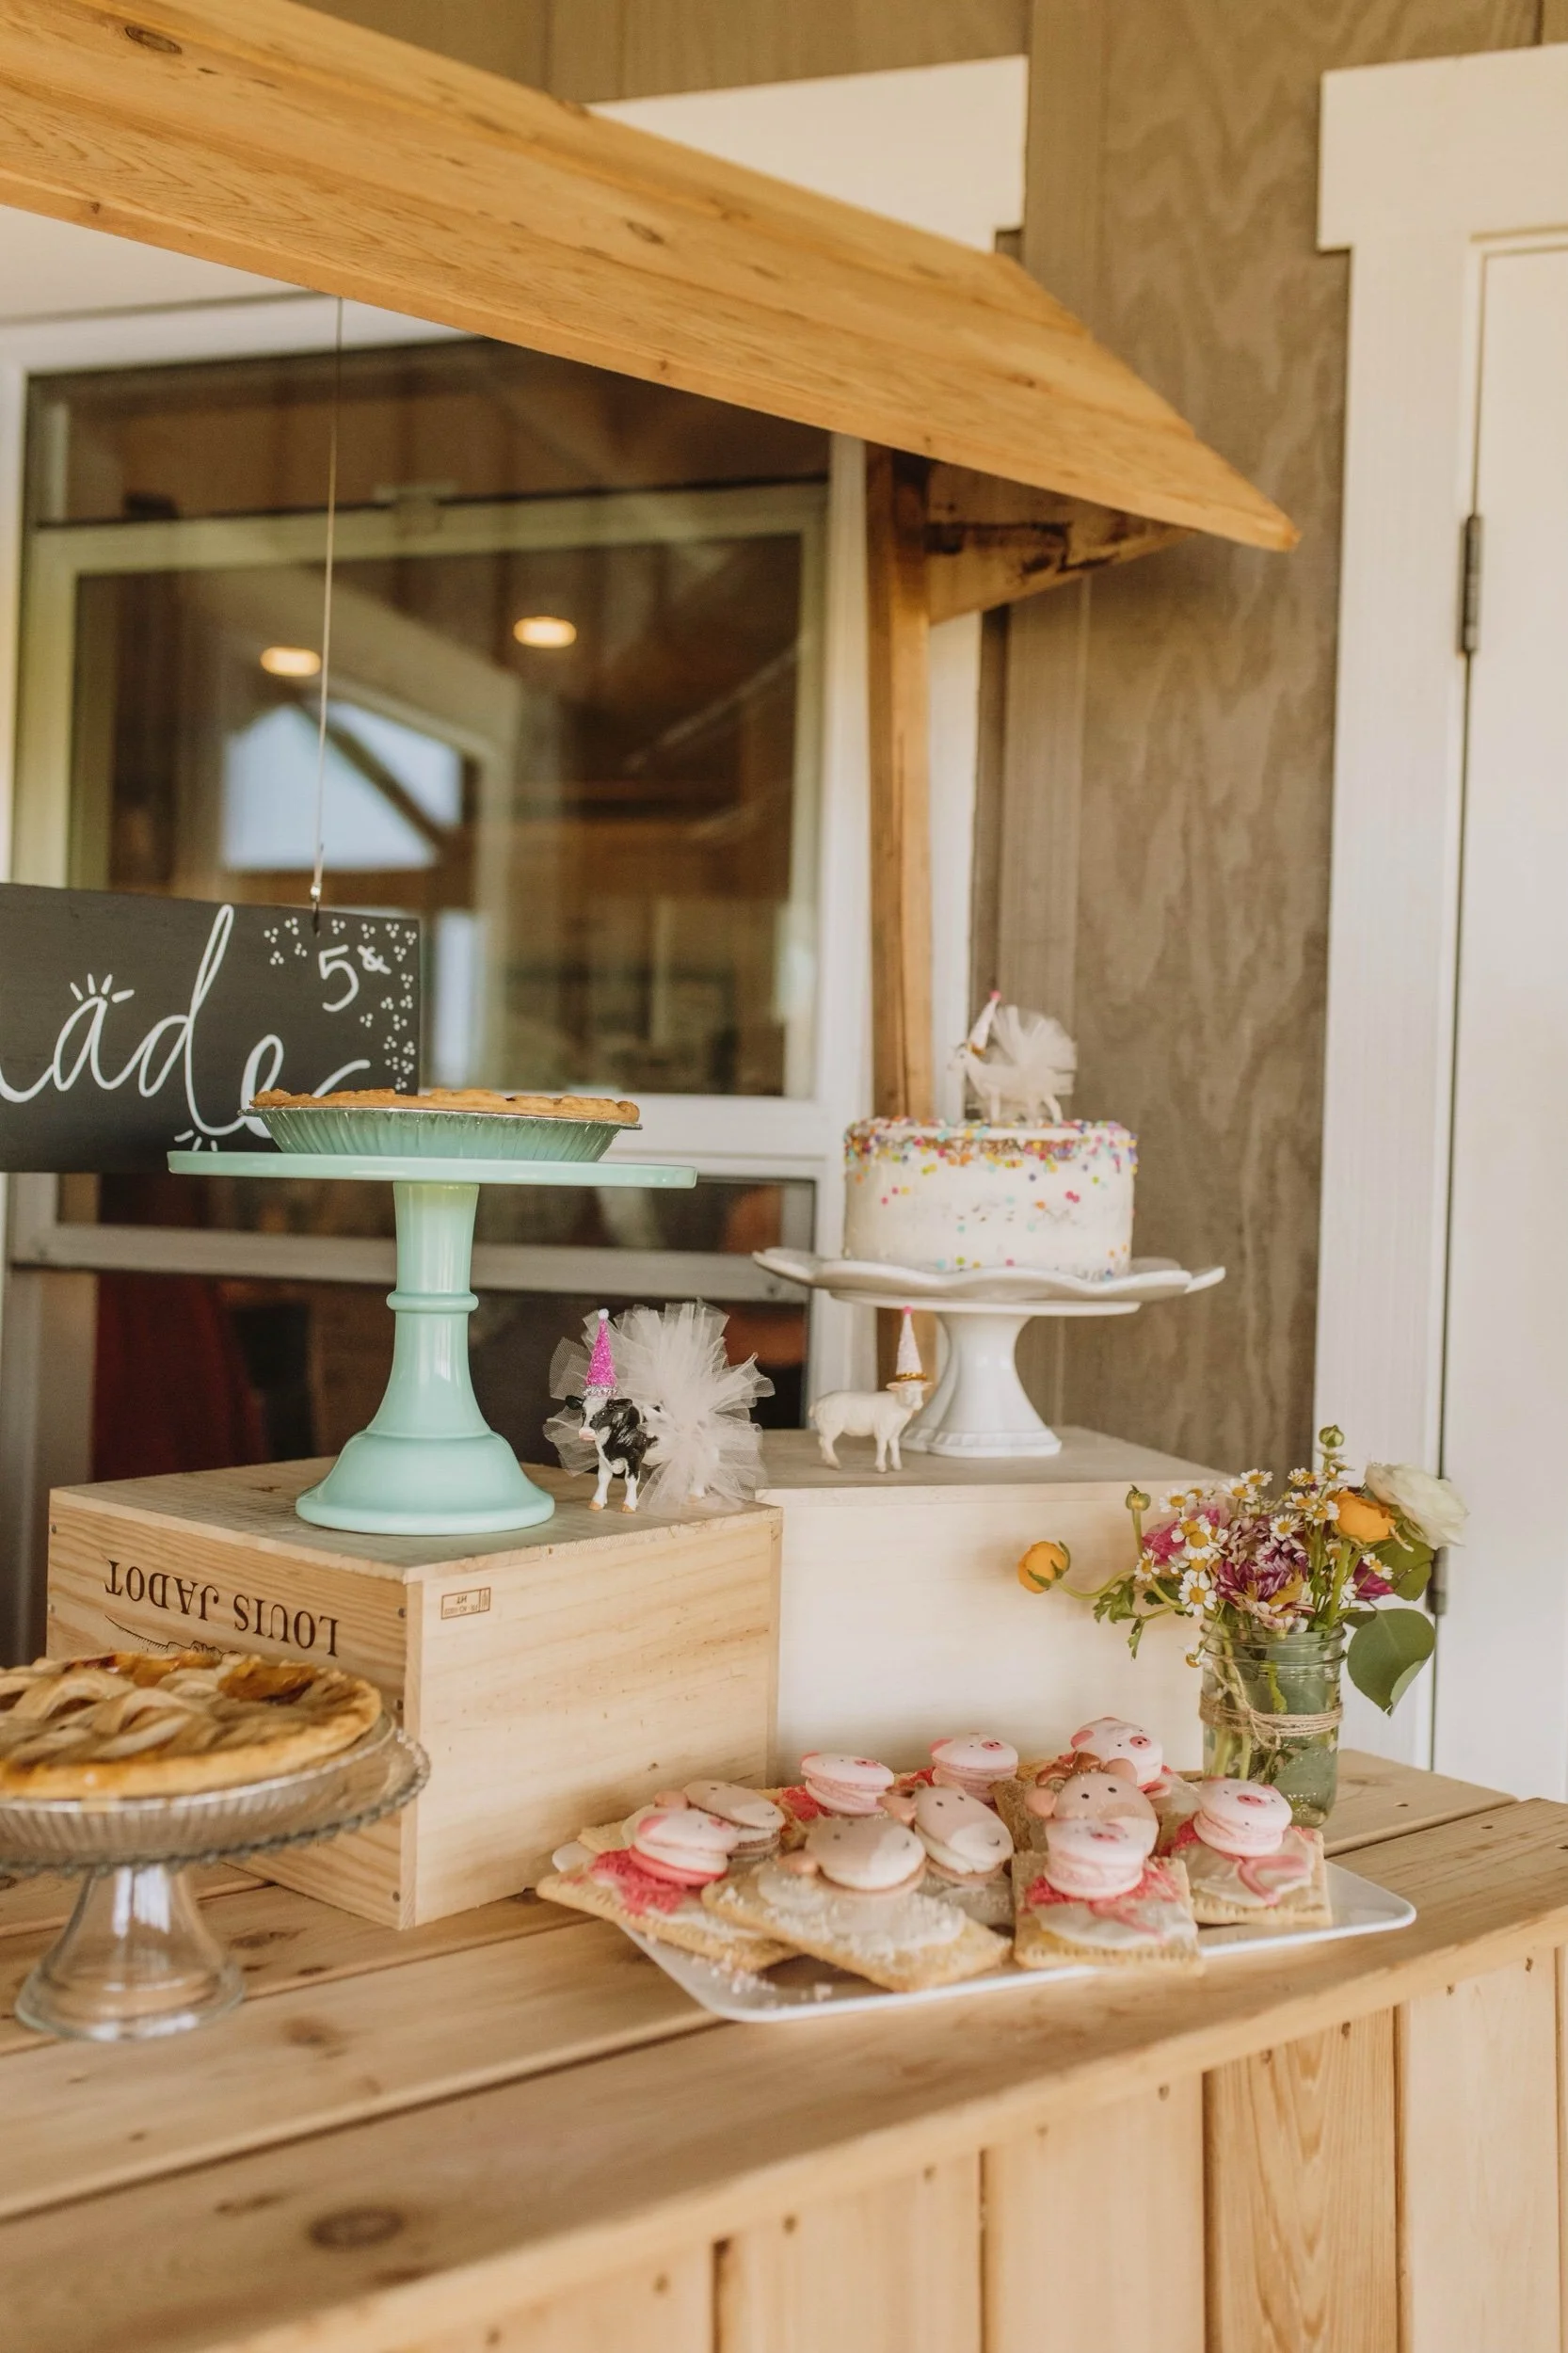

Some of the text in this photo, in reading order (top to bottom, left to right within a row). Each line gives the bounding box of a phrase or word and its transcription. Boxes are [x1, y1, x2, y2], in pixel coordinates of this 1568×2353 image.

[0, 904, 371, 1138] ade
[104, 1559, 340, 1657] LOUIS JADOT
